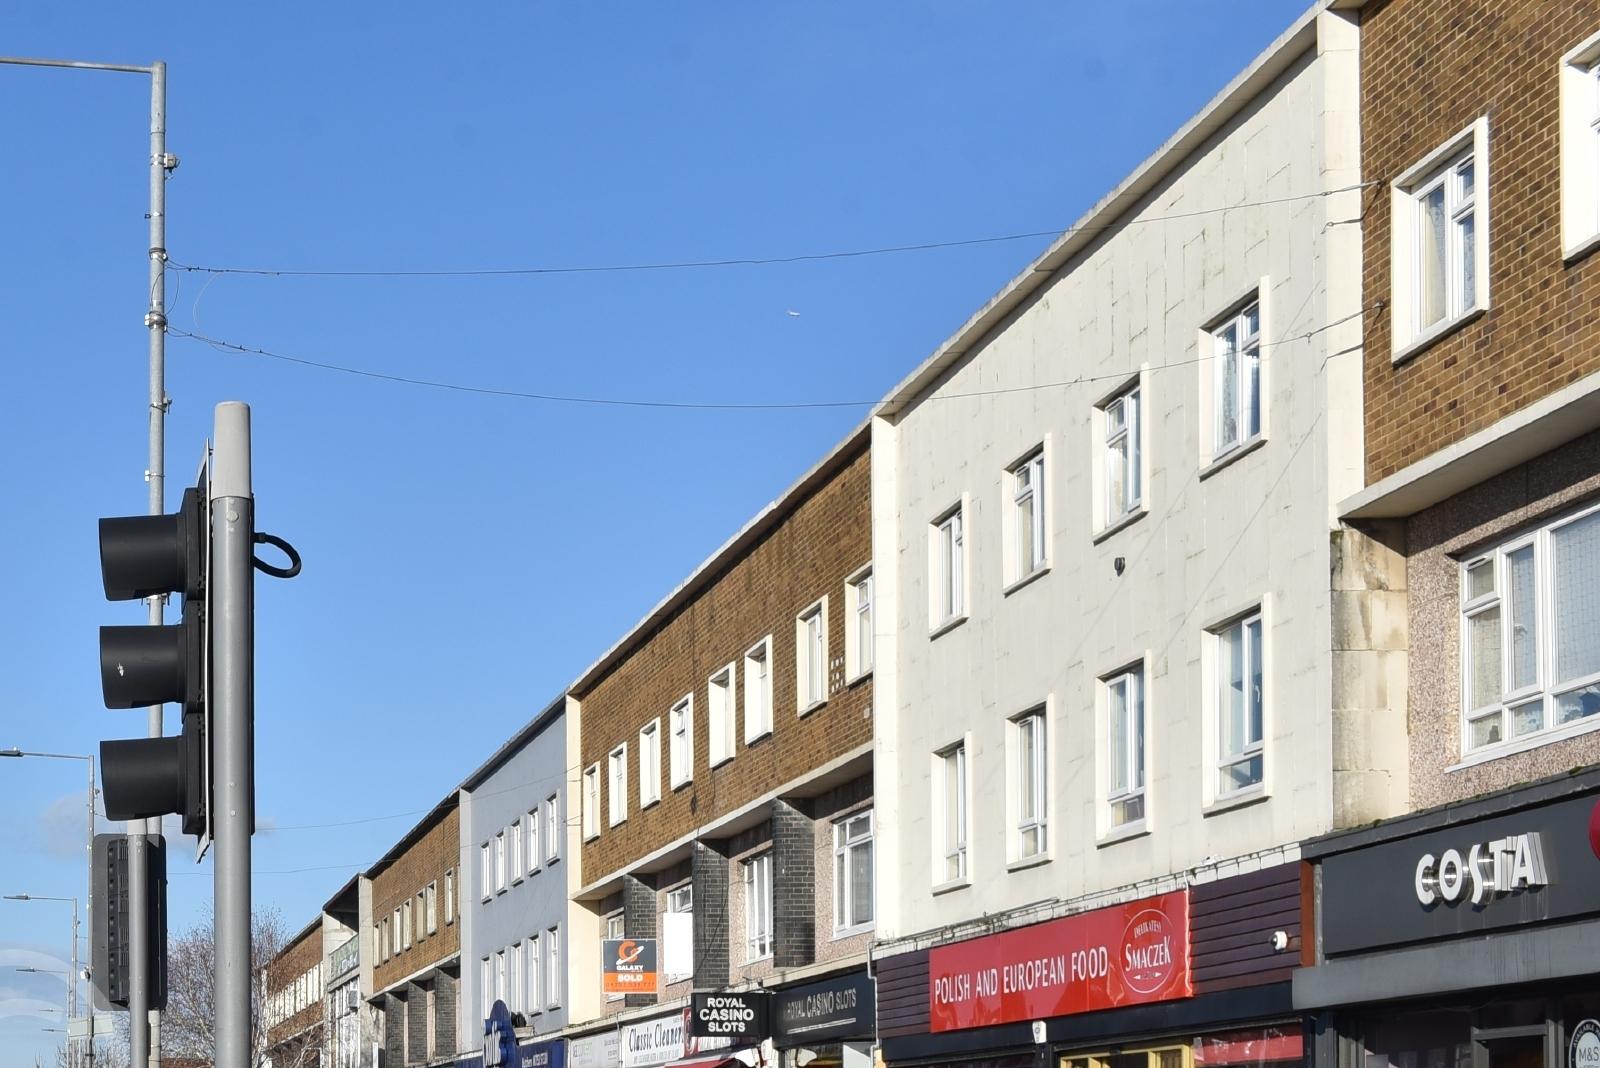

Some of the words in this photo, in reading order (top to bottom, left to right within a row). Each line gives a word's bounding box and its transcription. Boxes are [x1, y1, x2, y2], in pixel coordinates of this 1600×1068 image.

[1415, 831, 1548, 905] COSTA
[1125, 936, 1171, 972] SMACZEK
[617, 973, 643, 982] SOLD
[935, 972, 970, 1005] POLISH
[975, 968, 998, 998] AND
[1003, 955, 1065, 994] EUROPEAN
[1071, 946, 1108, 982] FOOD
[707, 997, 746, 1008] ROYAL
[785, 1001, 806, 1020] ROYAL
[806, 990, 835, 1018] CASINO
[835, 988, 857, 1011] SLOTS
[700, 1009, 754, 1021] CASINO
[707, 1022, 746, 1033] SLOTS
[629, 1026, 653, 1053] Classic
[1579, 1046, 1599, 1062] M&S
